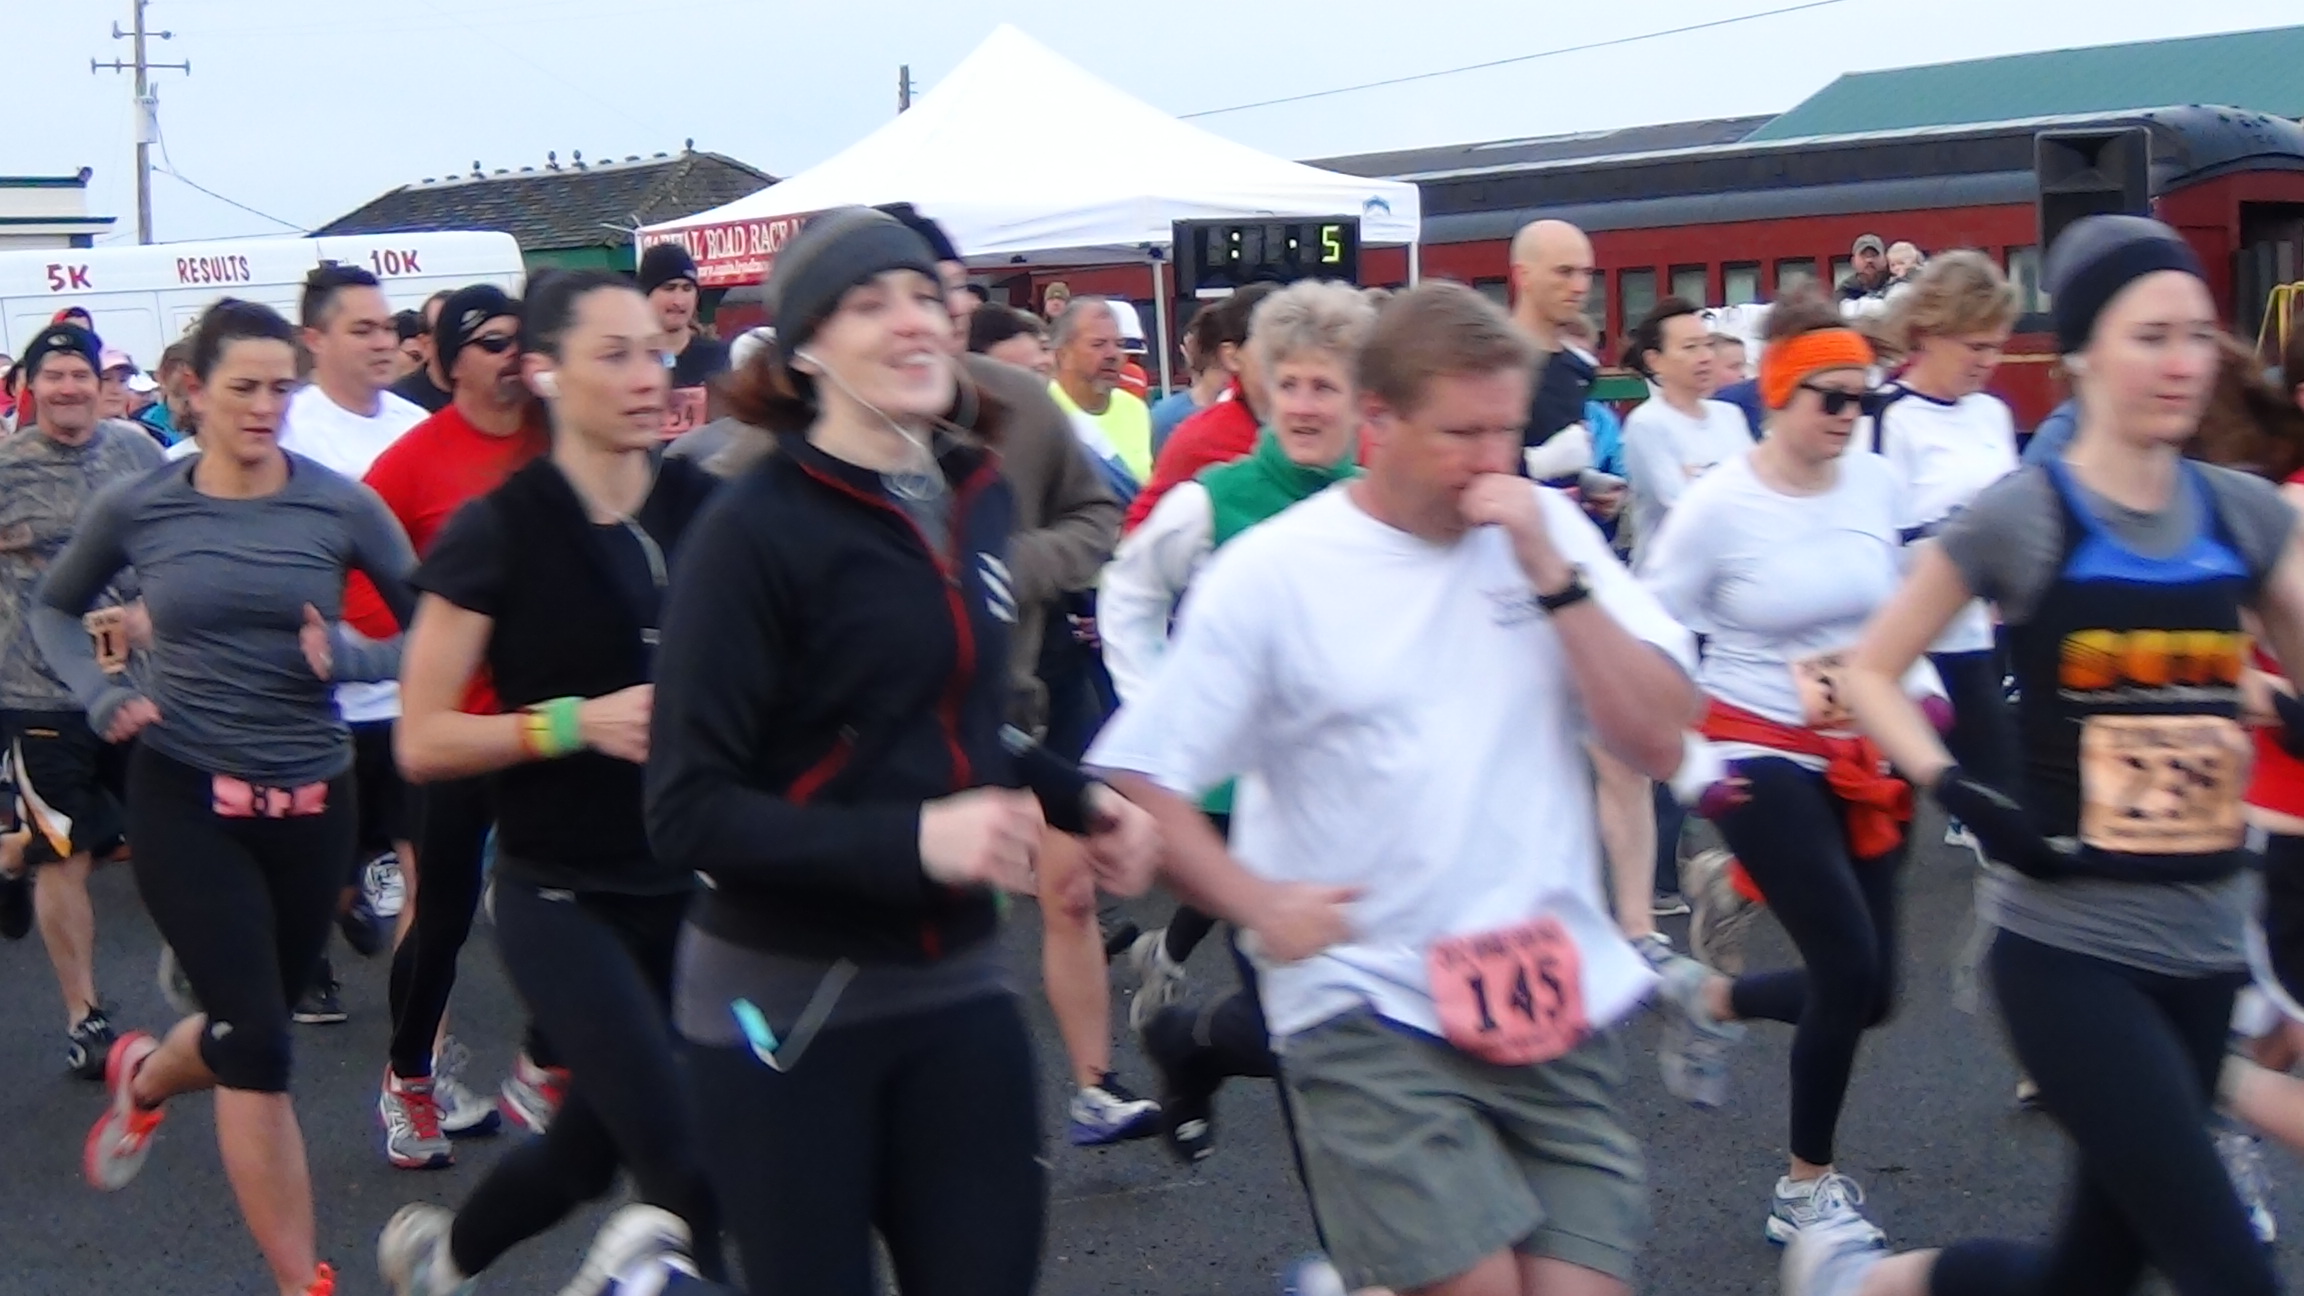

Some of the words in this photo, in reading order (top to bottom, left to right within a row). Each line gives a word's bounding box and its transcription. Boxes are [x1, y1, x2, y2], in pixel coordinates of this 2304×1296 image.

[705, 225, 745, 260] ROAD
[748, 220, 788, 255] RACE
[46, 264, 93, 292] 5K
[176, 255, 251, 284] RESULTS
[369, 249, 422, 276] 10K
[1467, 956, 1565, 1033] 145
